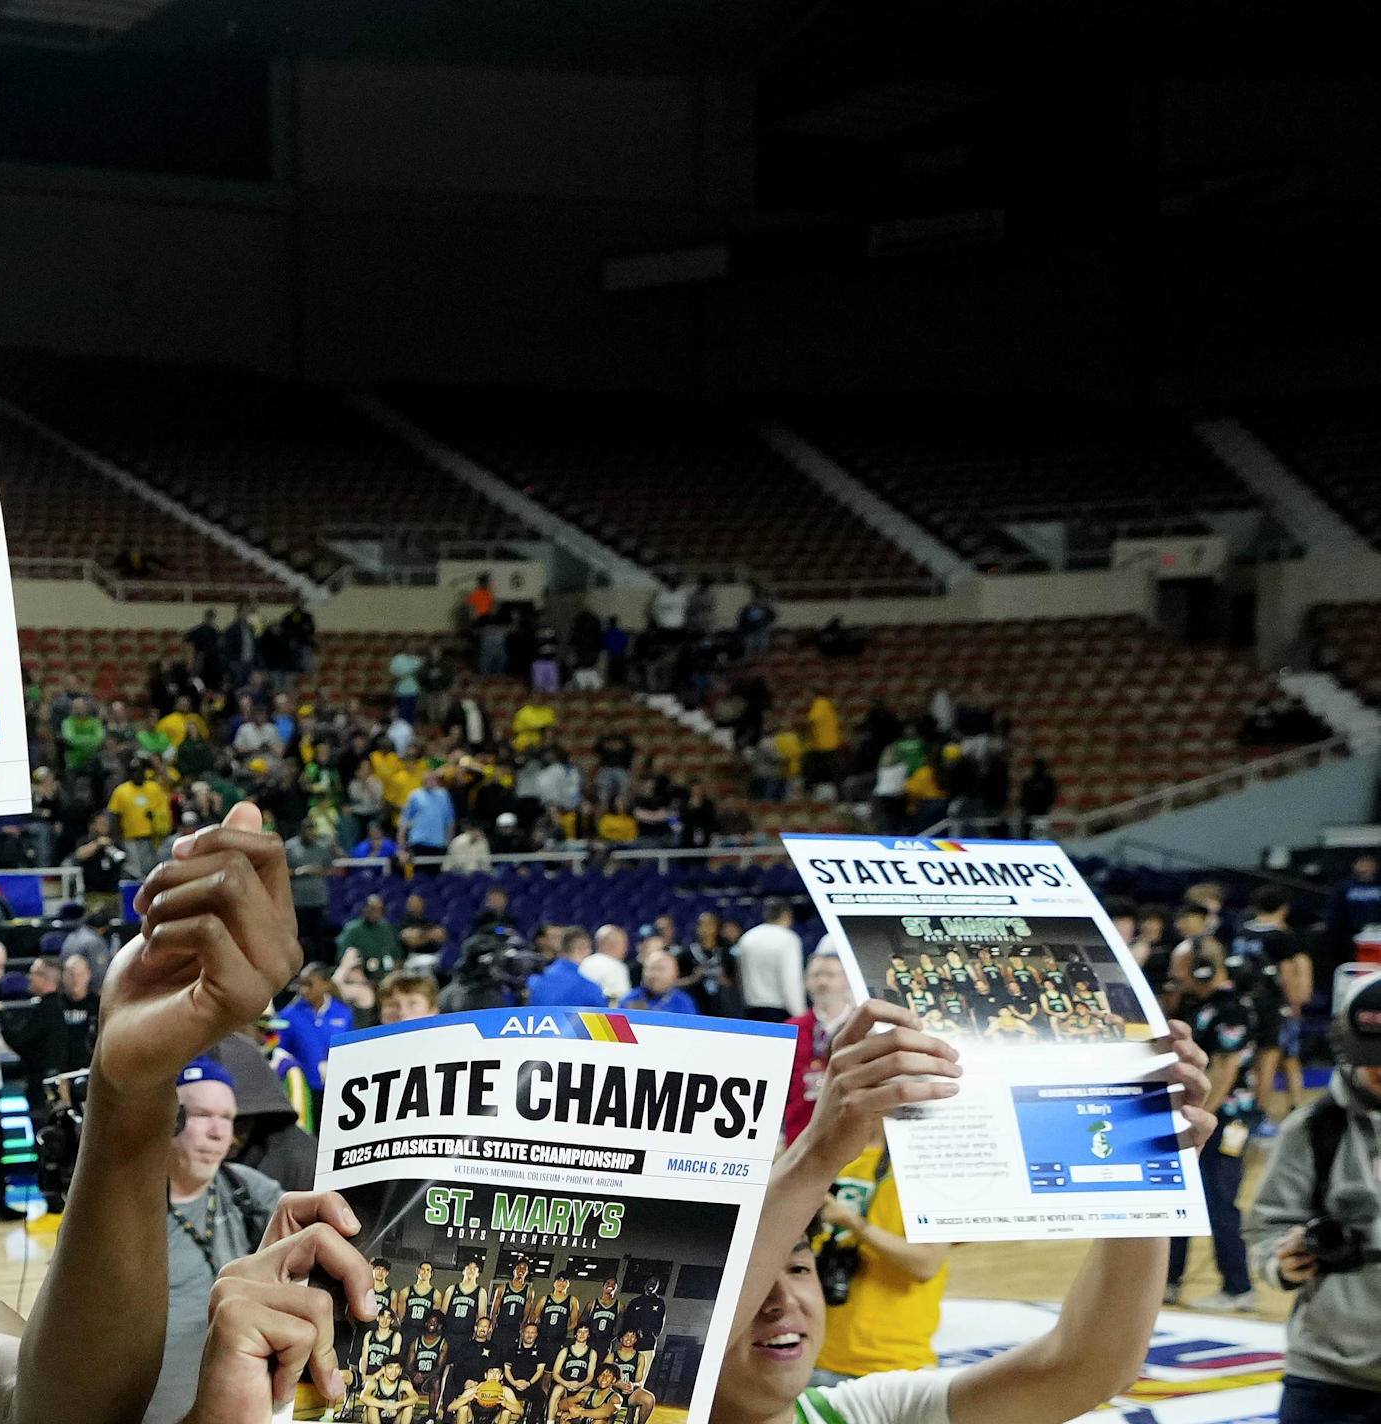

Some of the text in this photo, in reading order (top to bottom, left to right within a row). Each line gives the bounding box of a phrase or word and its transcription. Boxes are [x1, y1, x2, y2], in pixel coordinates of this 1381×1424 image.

[893, 840, 928, 851] AIA
[808, 858, 1072, 889] STATE CHAMPS!
[500, 1015, 561, 1036] AIA
[337, 1059, 768, 1140] STATE CHAMPS!
[340, 1138, 635, 1170] 2025 4A BASKETBALL STATE CHAMPIONSHIP
[453, 1165, 623, 1188] VETERANS MEMORIAL COLISEUM PHOENIX, ARIZONA
[666, 1158, 750, 1177] MARCH 6, 2025
[425, 1186, 625, 1239] ST. MARY'S
[446, 1226, 596, 1249] BOYS BASKETBALL
